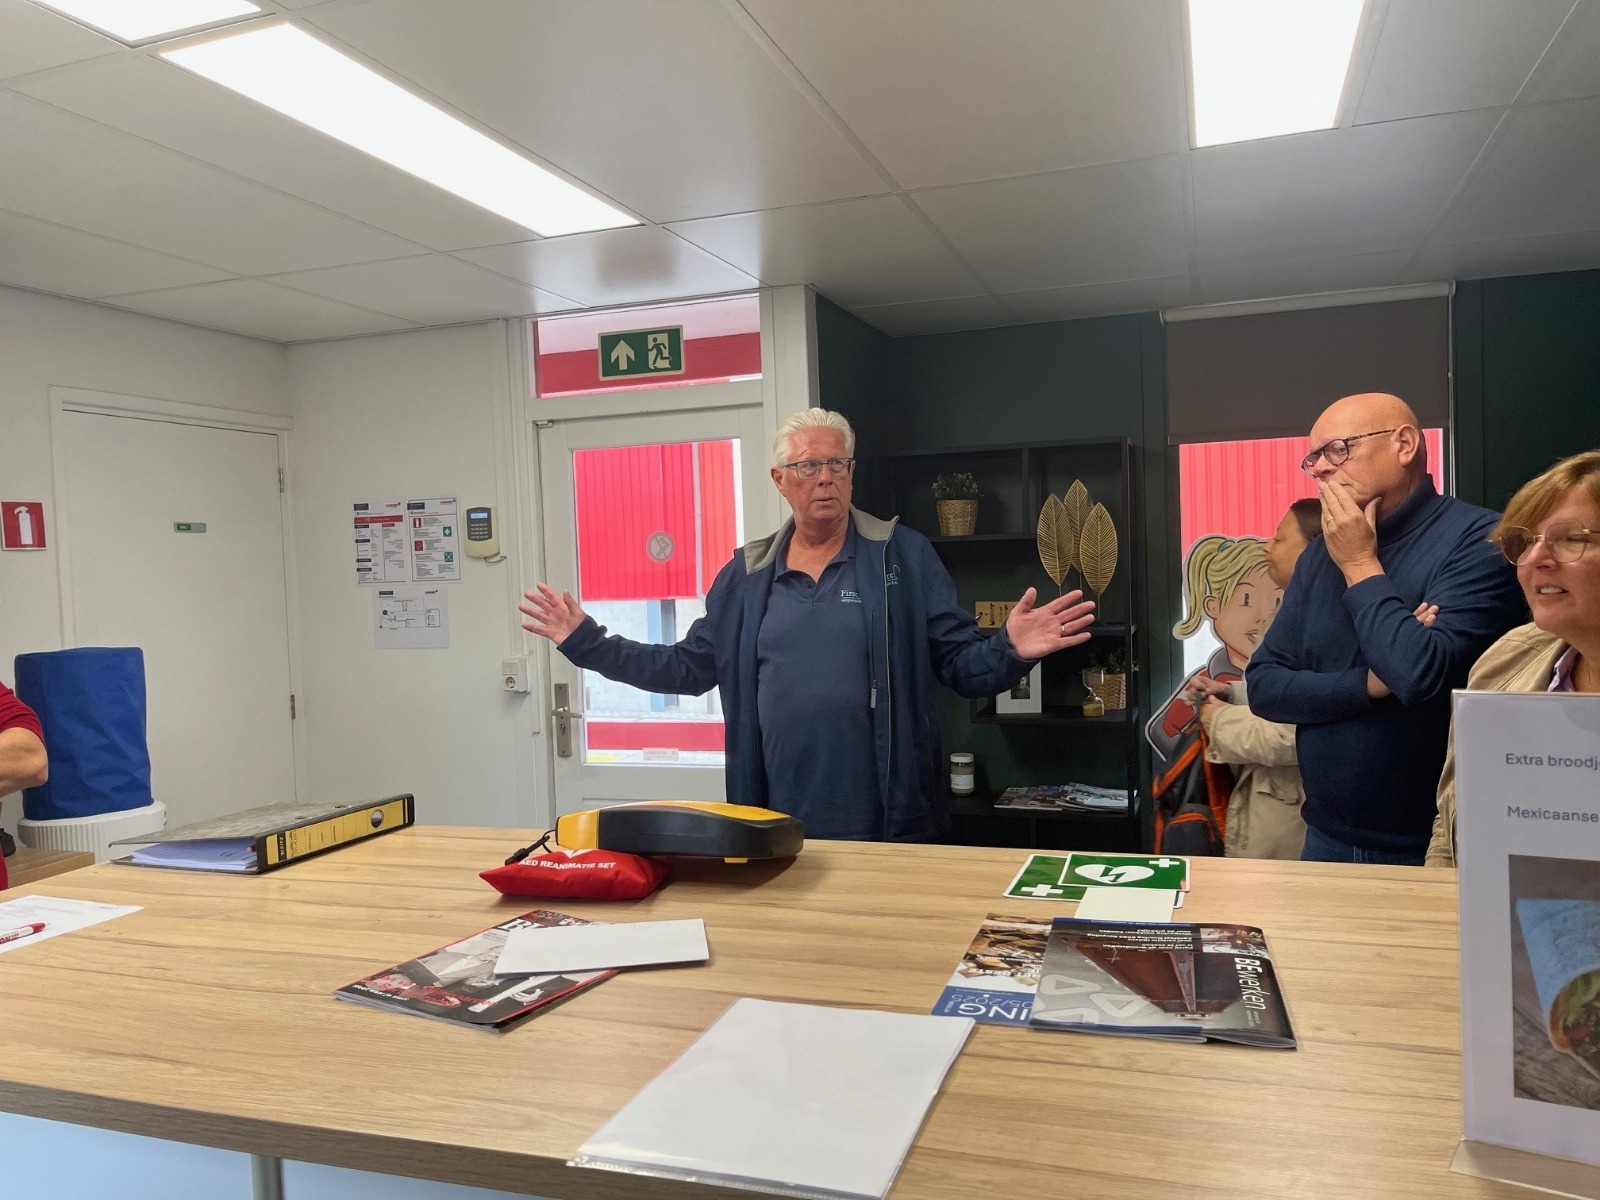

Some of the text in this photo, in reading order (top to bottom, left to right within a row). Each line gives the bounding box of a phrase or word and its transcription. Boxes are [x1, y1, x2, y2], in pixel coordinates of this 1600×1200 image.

[1505, 753, 1600, 771] Extra broodj
[1507, 805, 1599, 822] Mexicaanse
[540, 860, 597, 870] REANIMATIE
[1234, 957, 1271, 1010] BEwerken
[951, 994, 1034, 1008] 05/2025
